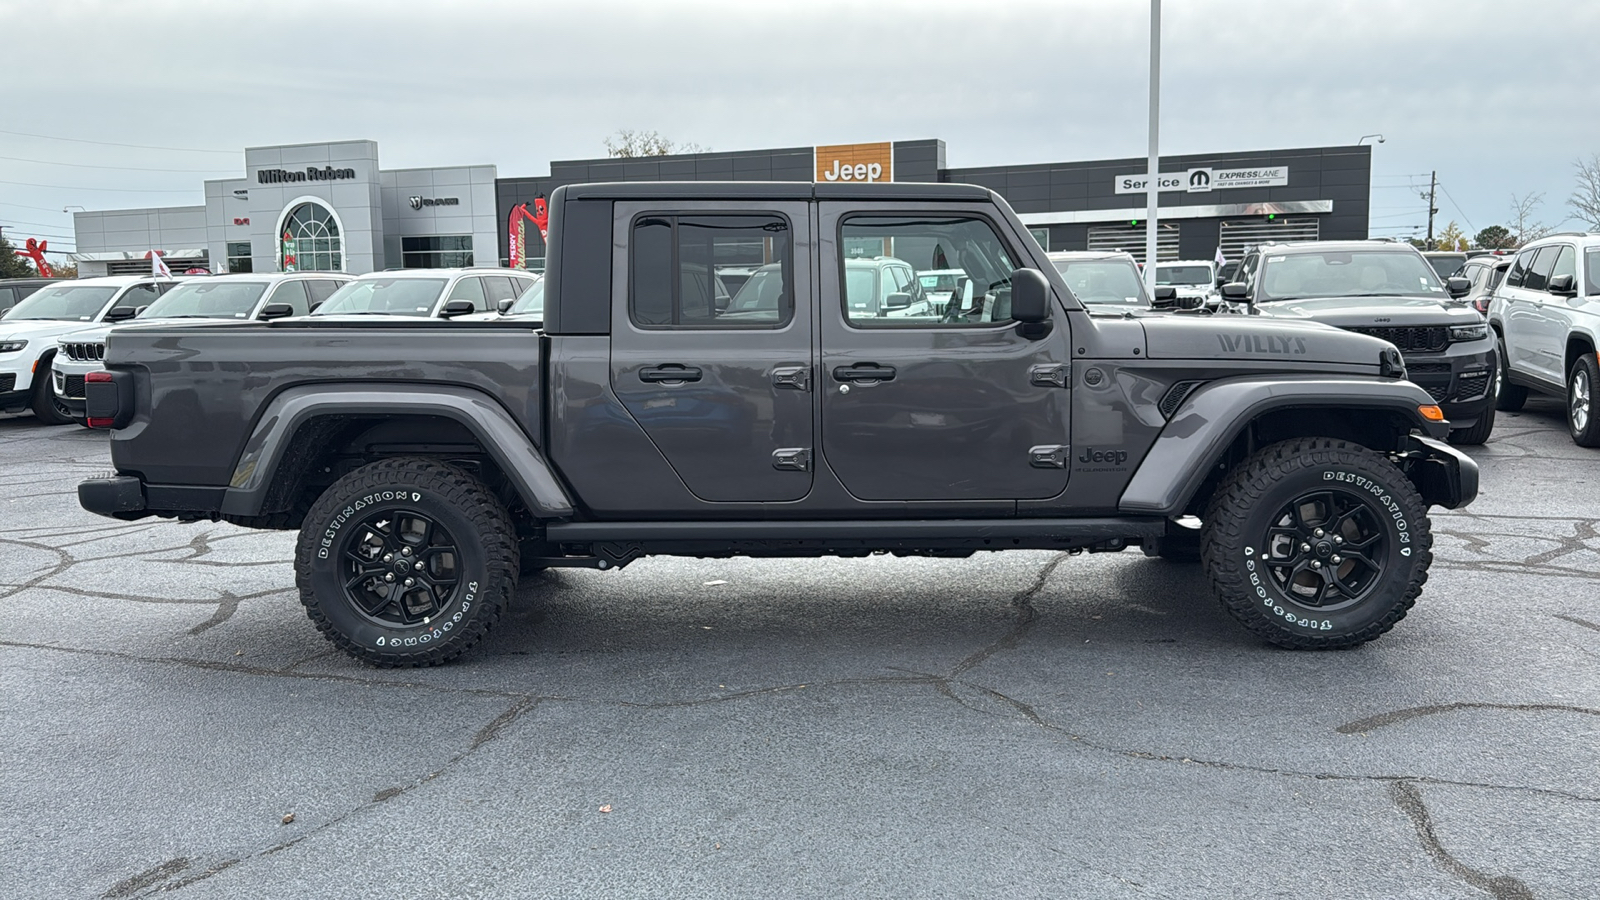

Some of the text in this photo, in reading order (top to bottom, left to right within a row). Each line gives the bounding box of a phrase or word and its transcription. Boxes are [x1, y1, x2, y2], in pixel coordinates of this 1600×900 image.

[257, 166, 355, 184] Milton Ruben
[824, 160, 882, 183] Jeep
[1123, 178, 1180, 190] Serice
[514, 218, 526, 270] hristmas
[1216, 334, 1307, 354] WILLYS
[1079, 446, 1128, 466] Jeep
[318, 491, 408, 559] DESTINATION
[1322, 471, 1411, 543] DESTINATION
[389, 581, 479, 647] Firestone
[1245, 560, 1333, 631] Firestone
